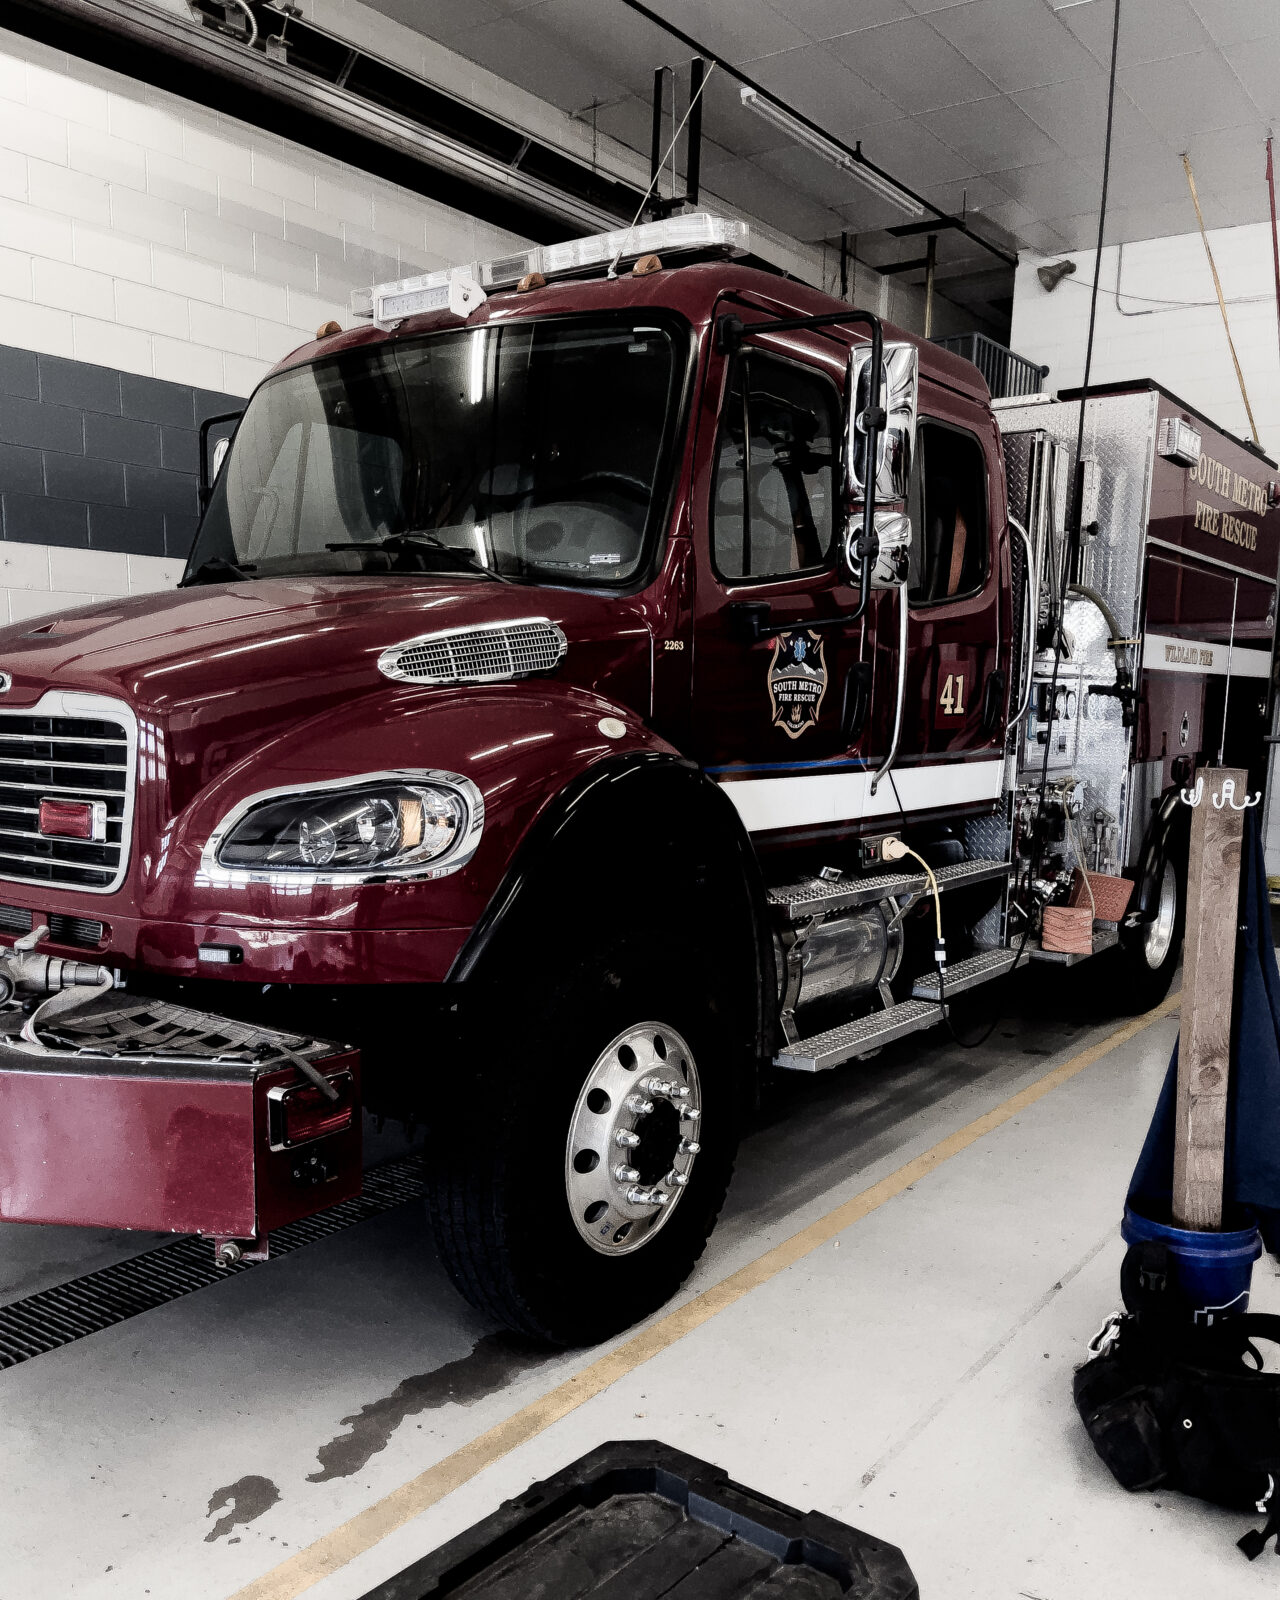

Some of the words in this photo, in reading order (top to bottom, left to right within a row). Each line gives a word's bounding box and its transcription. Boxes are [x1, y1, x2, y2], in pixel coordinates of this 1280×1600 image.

[1232, 472, 1268, 517] METRO
[1194, 500, 1220, 536] FIRE
[1221, 512, 1258, 552] RESCUE
[664, 640, 684, 650] 2263
[773, 680, 798, 694] SOUTH
[798, 680, 822, 694] METRO
[778, 693, 792, 702] FIRE
[793, 693, 816, 702] RESCUE
[939, 674, 965, 715] 41
